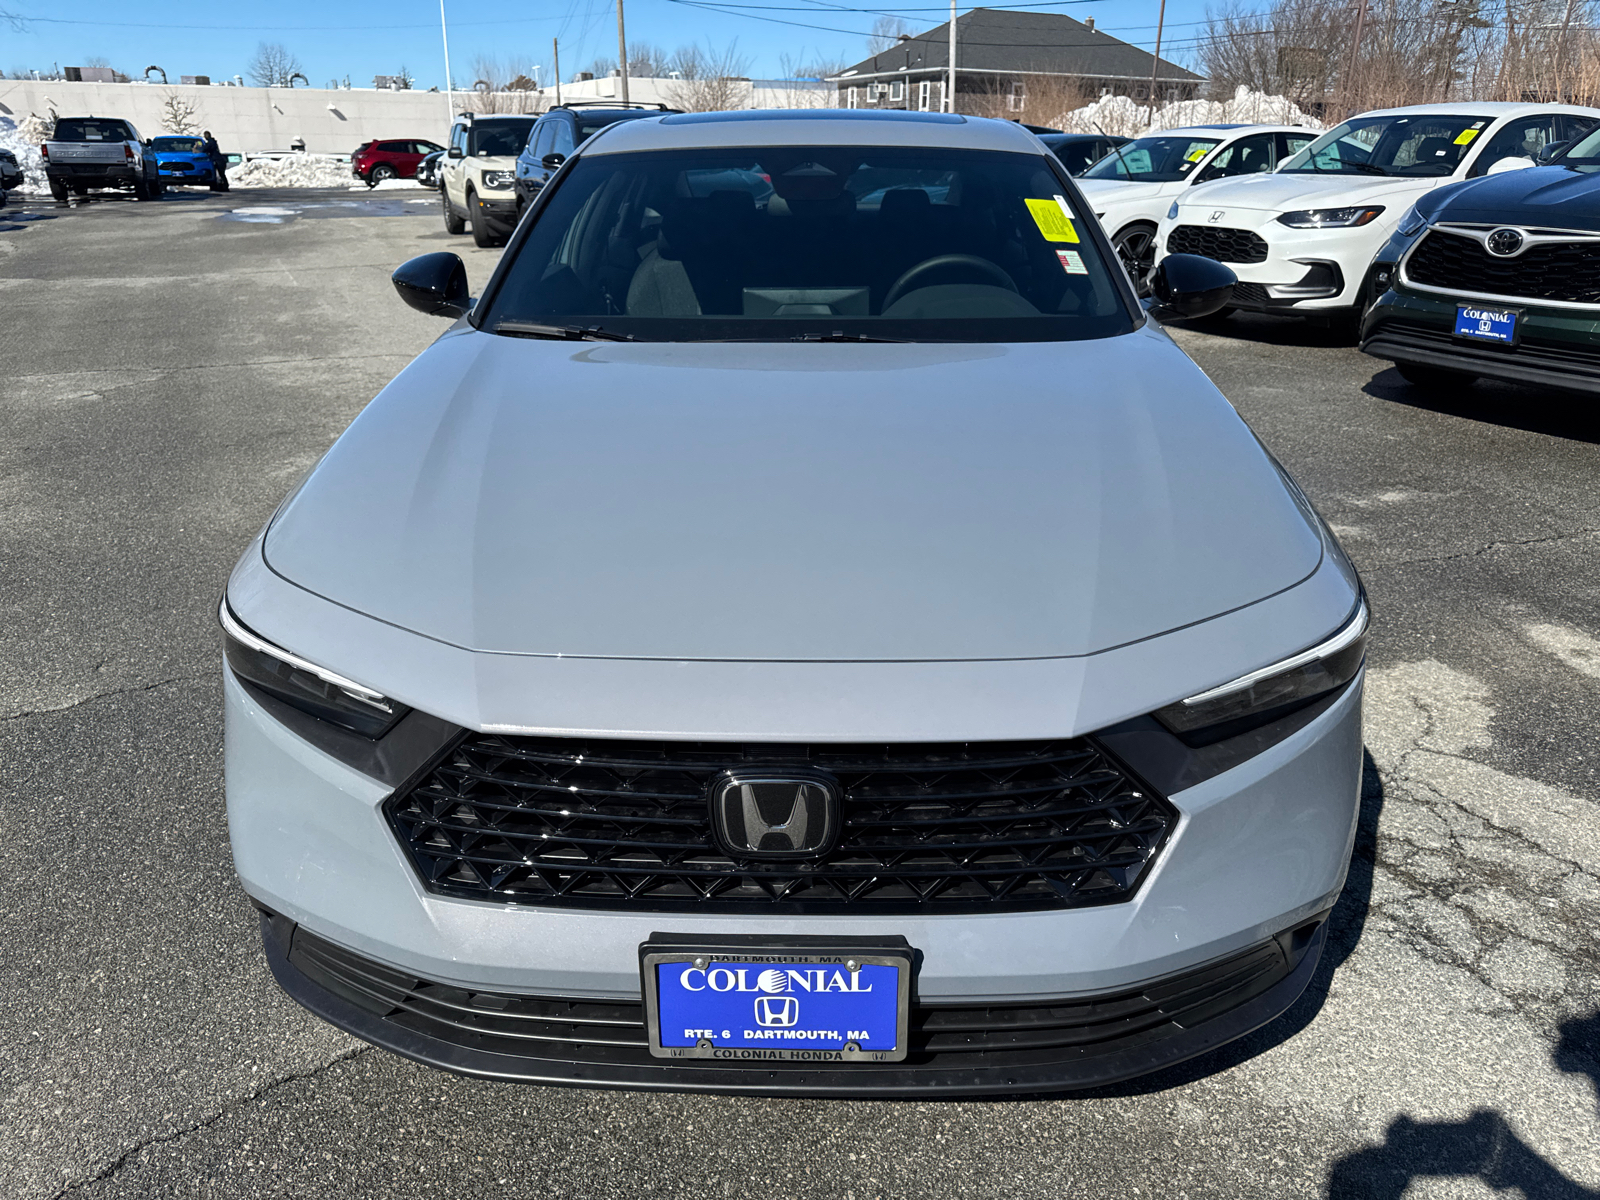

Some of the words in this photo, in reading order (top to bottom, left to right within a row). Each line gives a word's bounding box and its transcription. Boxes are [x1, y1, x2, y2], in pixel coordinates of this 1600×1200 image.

[680, 967, 873, 993] COLONIAL
[684, 1029, 718, 1039] RTE.
[721, 1030, 731, 1039] 6
[743, 1029, 843, 1041] DARTMOUTH,
[847, 1030, 870, 1040] MA
[713, 1049, 786, 1059] COLONIAL
[790, 1050, 844, 1061] HONDA
